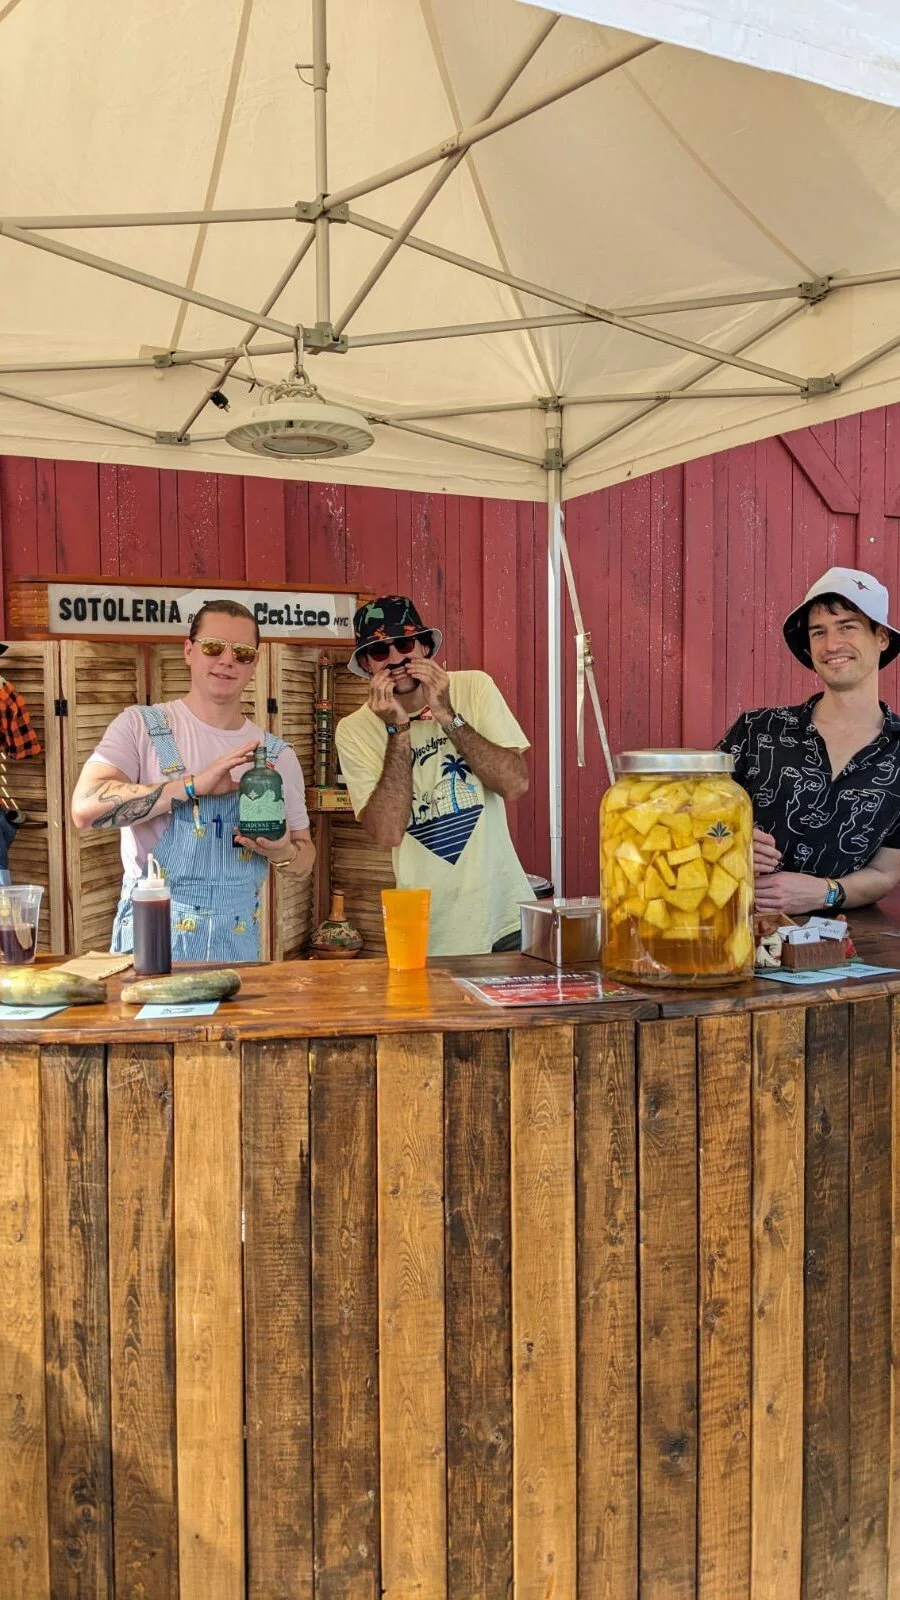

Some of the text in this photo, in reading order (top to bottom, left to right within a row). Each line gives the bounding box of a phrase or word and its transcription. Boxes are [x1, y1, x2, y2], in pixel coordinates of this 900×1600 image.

[59, 598, 196, 624] SOTOLERIA B
[254, 602, 349, 627] Calico NYC
